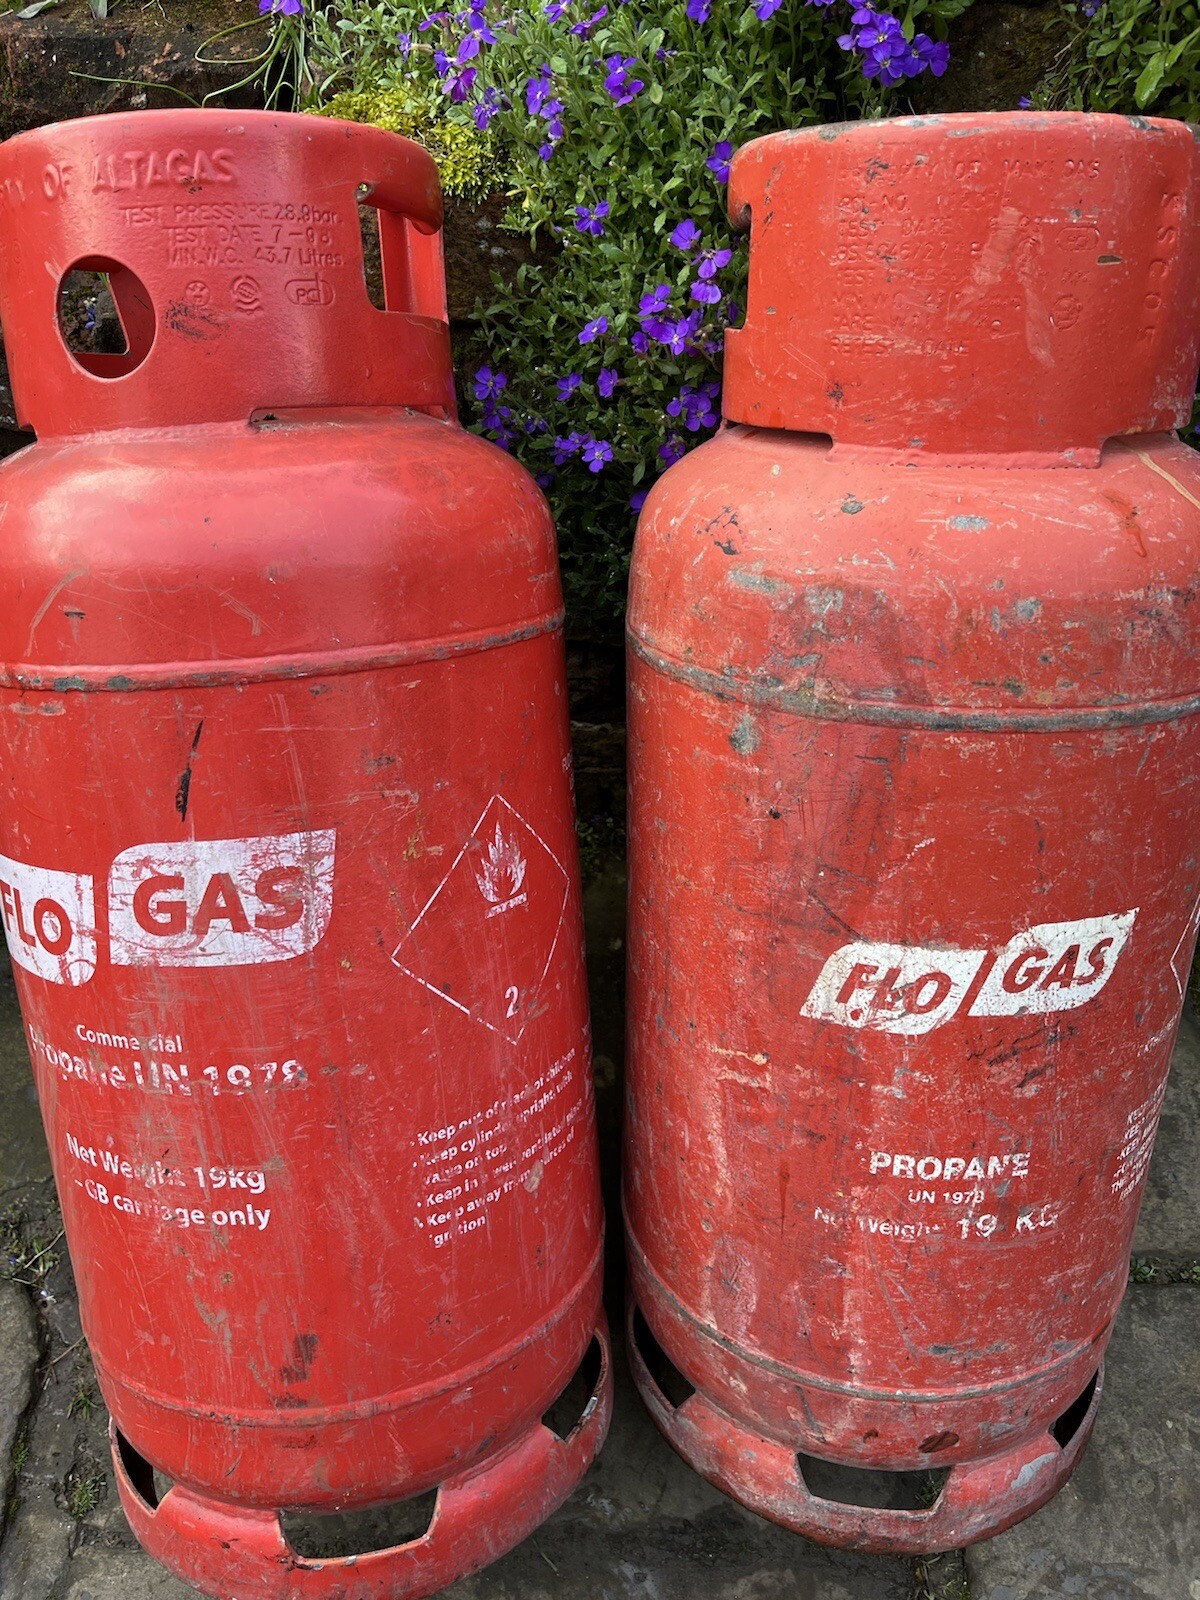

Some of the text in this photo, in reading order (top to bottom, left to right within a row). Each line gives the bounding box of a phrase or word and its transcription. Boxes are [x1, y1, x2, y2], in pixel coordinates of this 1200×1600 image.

[92, 148, 240, 196] ALTAGAS
[119, 204, 164, 226] TEST
[174, 201, 270, 222] PRESSURE
[161, 224, 209, 247] TEST
[217, 223, 263, 244] DATE
[0, 865, 304, 956] FLO GAS
[835, 937, 1114, 1015] FLO GAS
[504, 985, 519, 1019] 2
[76, 1023, 183, 1053] Commecial
[133, 1060, 191, 1096] UN
[417, 1125, 456, 1147] Keep
[66, 1132, 98, 1167] Net
[193, 1166, 267, 1195] 19kg
[868, 1151, 1031, 1181] PROPANE
[426, 1185, 462, 1207] Keep
[467, 1188, 501, 1213] away
[503, 1170, 531, 1193] frm
[908, 1189, 935, 1204] UN
[212, 1203, 271, 1231] only
[429, 1215, 486, 1249] gntion
